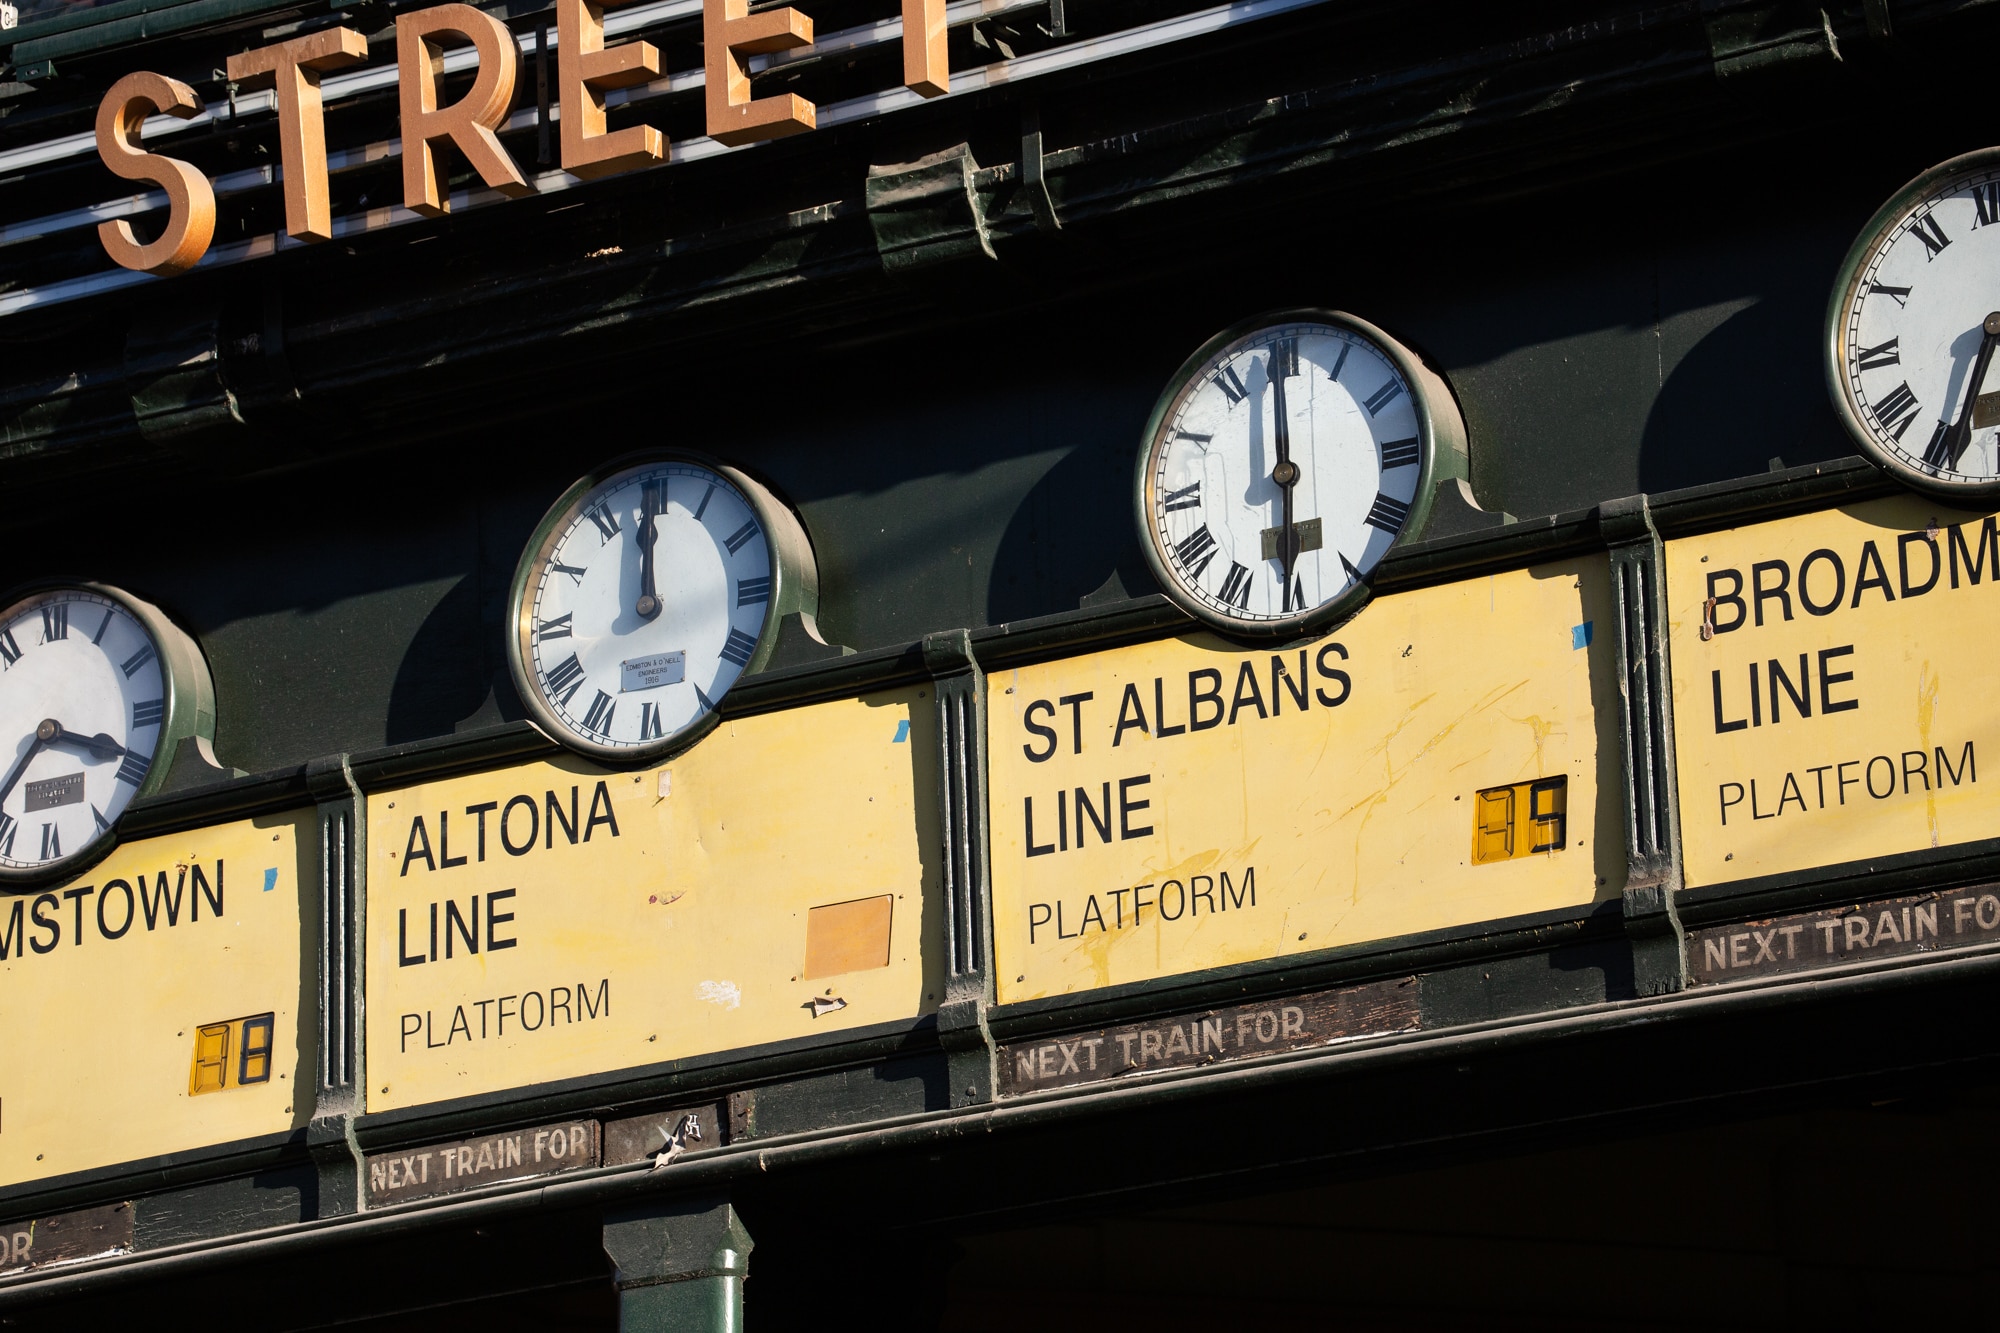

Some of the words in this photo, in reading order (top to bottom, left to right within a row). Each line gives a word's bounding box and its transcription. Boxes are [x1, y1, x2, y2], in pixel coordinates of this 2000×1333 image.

[1705, 516, 2000, 635] BROADM
[626, 661, 652, 671] EDMISTON
[638, 667, 667, 677] ENGINEERS
[645, 676, 659, 684] 1916
[1023, 691, 1093, 762] ST
[1113, 643, 1351, 747] ALBANS
[1712, 645, 1858, 734] LINE
[1025, 774, 1153, 857] LINE
[1720, 741, 1976, 825] PLATFORM
[399, 780, 620, 877] ALTONA
[400, 888, 516, 967] LINE
[1029, 866, 1256, 944] PLATFORM
[1704, 925, 1803, 971] NEXT
[1816, 903, 1938, 954] TRAIN
[401, 978, 609, 1053] PLATFORM
[1016, 1038, 1104, 1082] NEXT
[1115, 1018, 1222, 1066] TRAIN
[1236, 1006, 1305, 1047] FOR
[371, 1153, 432, 1192] NEXT
[440, 1136, 521, 1178] TRAIN
[535, 1126, 589, 1162] FOR
